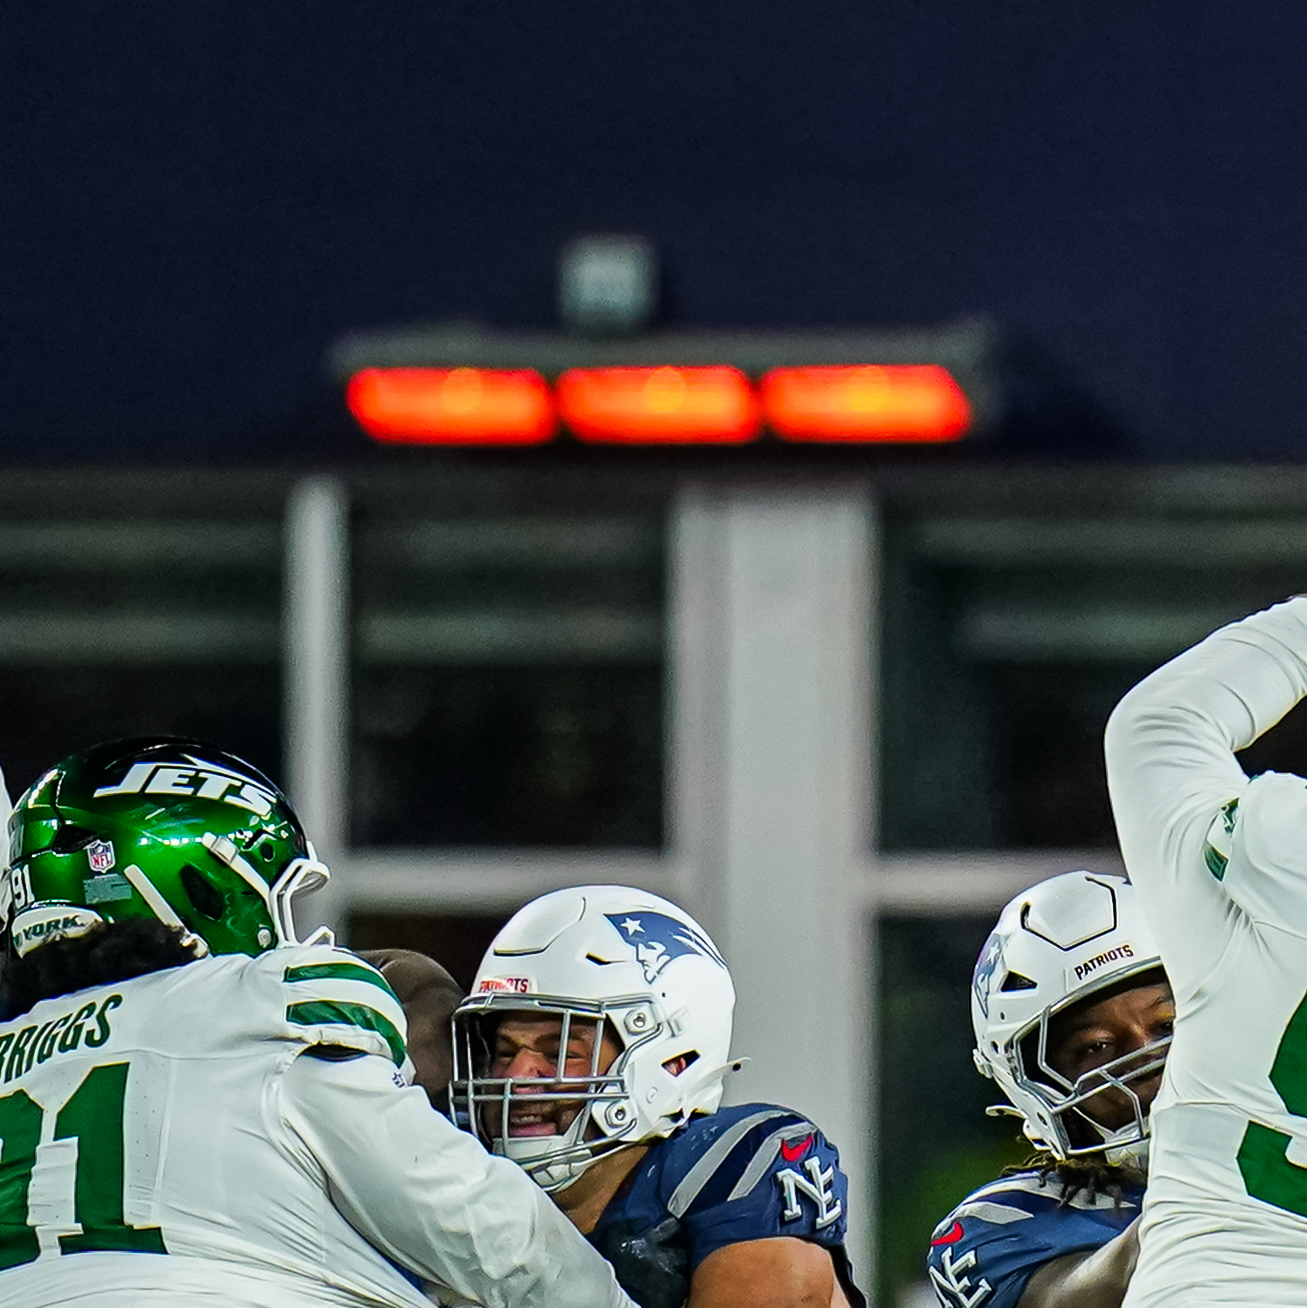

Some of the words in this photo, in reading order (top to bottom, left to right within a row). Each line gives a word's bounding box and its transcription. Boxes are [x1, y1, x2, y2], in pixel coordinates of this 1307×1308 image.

[93, 753, 277, 817] JETS
[11, 865, 35, 910] 91
[1074, 944, 1134, 981] PATRIOTS
